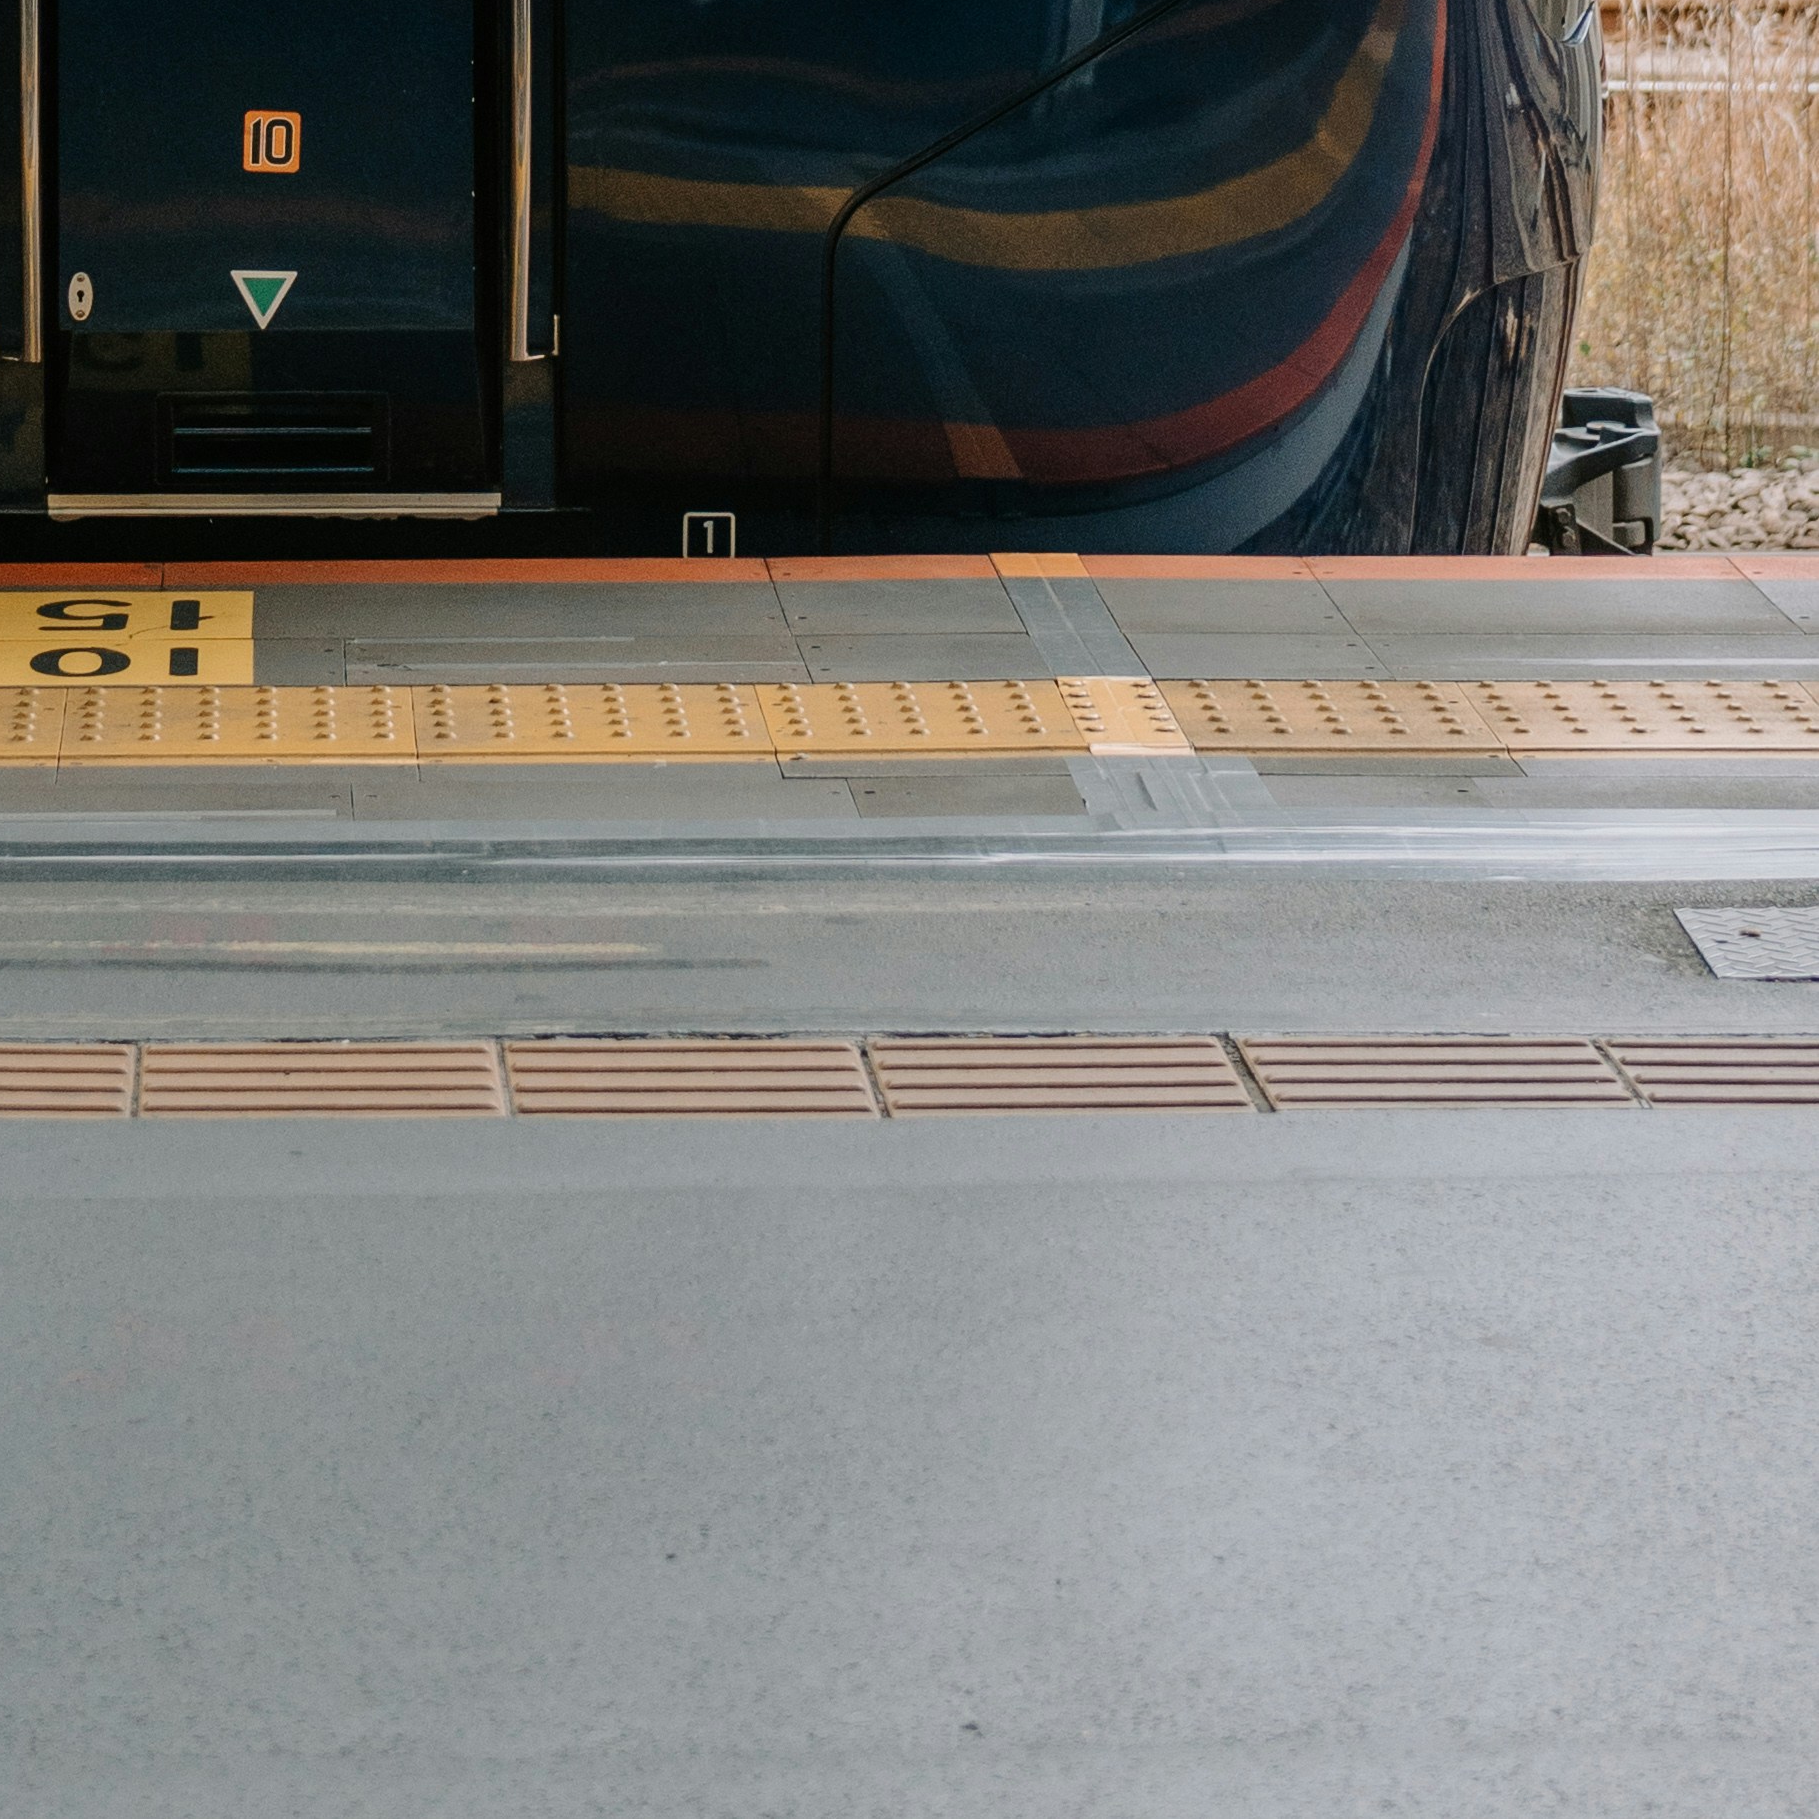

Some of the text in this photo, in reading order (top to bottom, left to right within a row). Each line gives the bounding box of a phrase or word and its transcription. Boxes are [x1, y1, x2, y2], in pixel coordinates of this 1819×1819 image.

[249, 116, 296, 167] 10
[702, 520, 715, 554] 1
[35, 599, 201, 631] 15
[29, 647, 199, 677] 10
